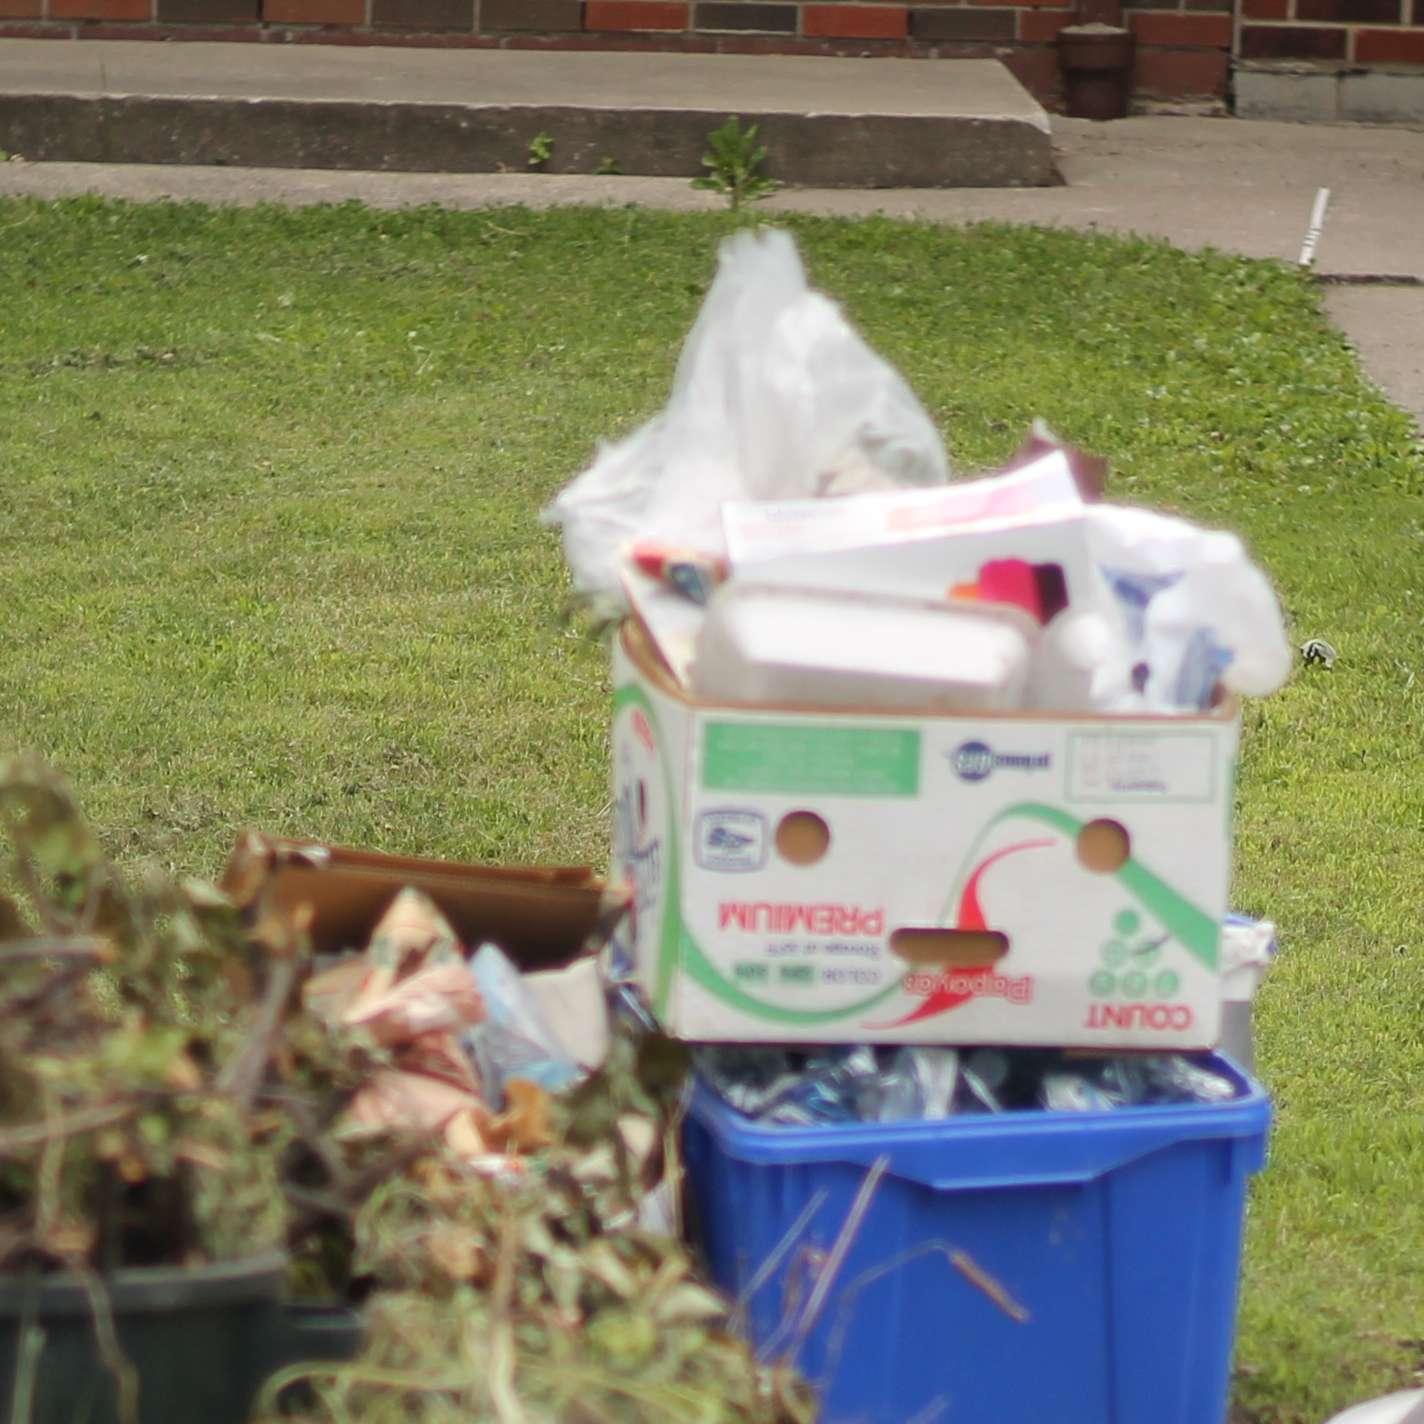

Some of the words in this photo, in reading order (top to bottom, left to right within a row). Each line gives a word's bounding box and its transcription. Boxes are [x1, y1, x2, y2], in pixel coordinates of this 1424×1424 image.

[718, 902, 885, 937] PREMIUM
[902, 974, 1033, 1005] Papayas
[1084, 1003, 1195, 1031] COUNT
